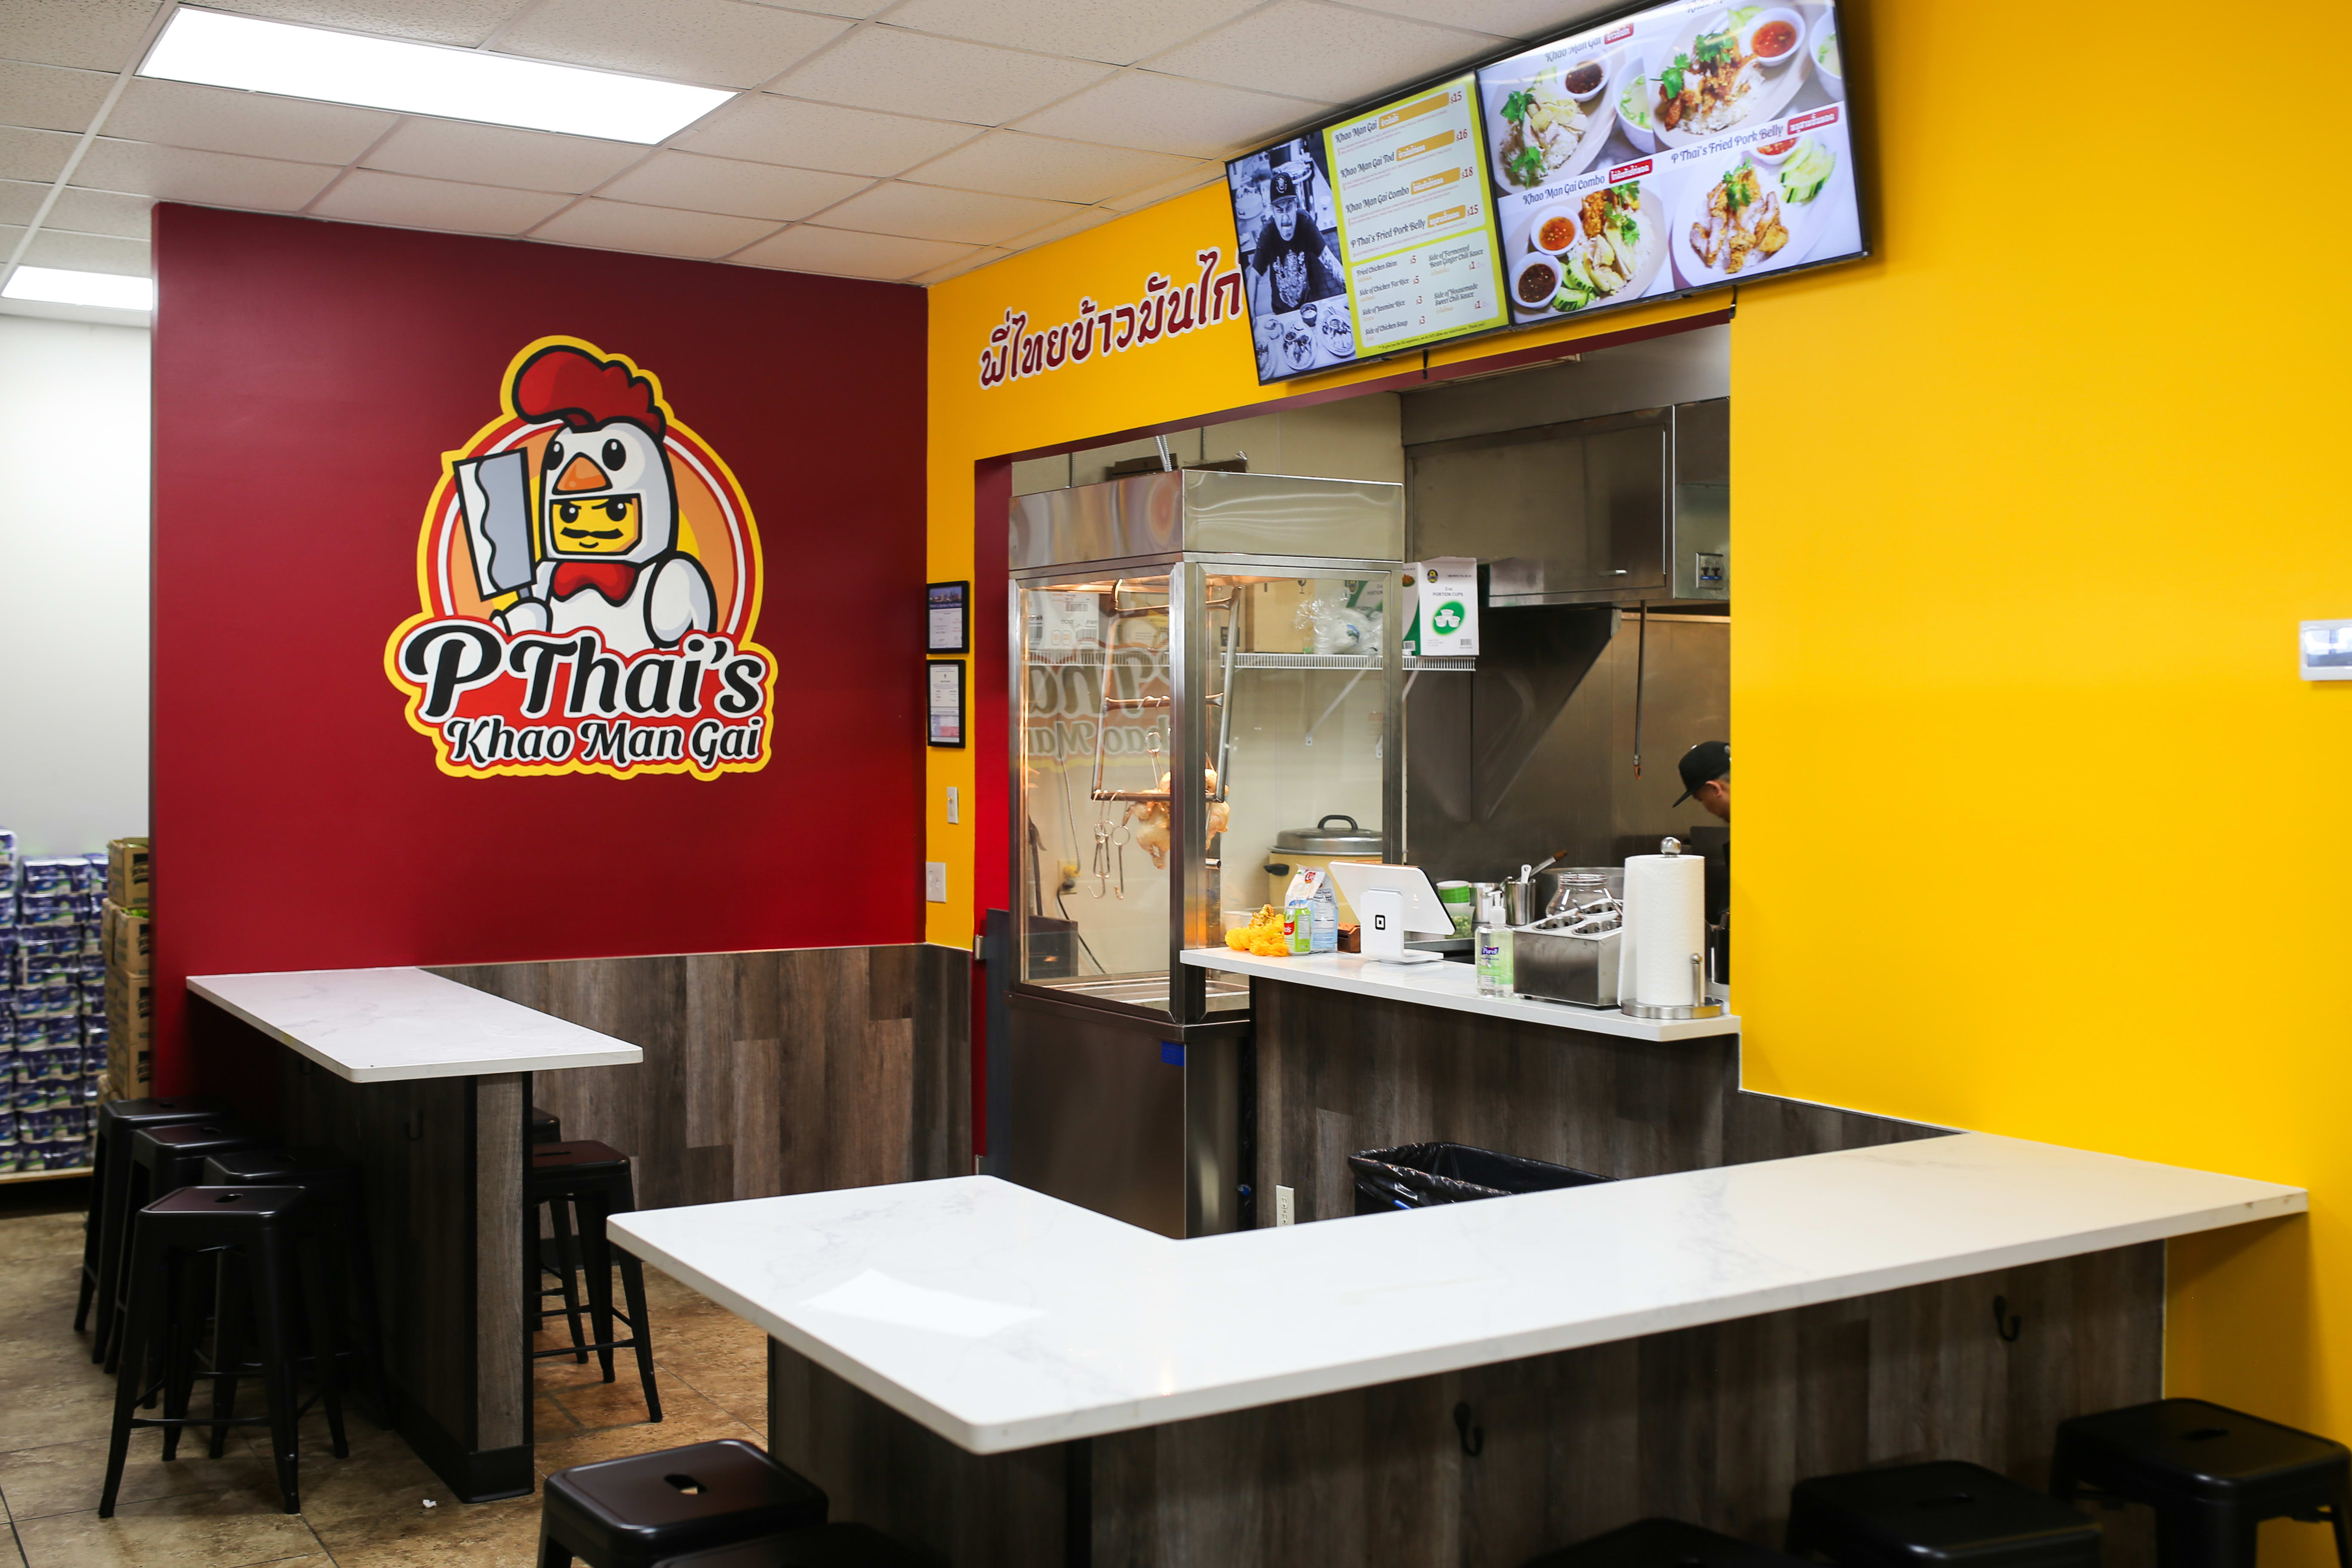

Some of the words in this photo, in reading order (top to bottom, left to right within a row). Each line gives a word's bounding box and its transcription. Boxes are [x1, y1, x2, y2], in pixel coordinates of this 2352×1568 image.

[1546, 49, 1567, 62] Khao
[1568, 41, 1587, 54] Man
[1451, 91, 1462, 104] $15
[1335, 132, 1351, 143] Khao
[1352, 126, 1366, 136] Man
[1367, 120, 1377, 133] Gai
[1456, 129, 1467, 141] $16
[1671, 153, 1678, 163] P
[1680, 145, 1707, 161] Thai's
[1709, 137, 1733, 154] Fried
[1734, 131, 1758, 146] Pork
[1759, 124, 1783, 139] Belly
[1340, 167, 1357, 178] Khao
[1358, 162, 1372, 172] Man
[1372, 156, 1382, 168] Gai
[1383, 152, 1395, 163] Tod
[1462, 167, 1473, 179] $18
[1523, 192, 1544, 205] Khao
[1545, 188, 1563, 199] Man
[1565, 181, 1577, 195] Gai
[1578, 175, 1605, 189] Combo
[1345, 203, 1362, 213] Khao
[1363, 198, 1377, 208] Man
[1378, 192, 1387, 205] Gai
[1388, 187, 1409, 199] Combo
[1467, 205, 1479, 216] $15
[1351, 239, 1356, 248] P
[1357, 234, 1375, 246] Thai's
[1375, 228, 1392, 241] Fried
[1393, 224, 1409, 236] Pork
[1409, 219, 1426, 231] Belly
[1442, 256, 1458, 266] Ginger
[1470, 249, 1483, 257] Sauce
[1443, 244, 1470, 258] Fermented
[1410, 255, 1416, 264] $5
[1357, 267, 1368, 276] Fried
[1369, 264, 1385, 273] Chicken
[1386, 260, 1398, 269] Skins
[1413, 276, 1419, 285] $5
[1374, 283, 1390, 292] Chicken
[1448, 283, 1478, 295] Housemade
[1416, 296, 1422, 305] $3
[1436, 298, 1449, 306] Sweet
[1377, 303, 1395, 313] Jasmine
[980, 251, 1241, 386] พี่ไทยข้าวมันไก
[1419, 315, 1425, 325] $3
[1379, 323, 1396, 331] Chicken
[404, 625, 502, 717] P
[509, 636, 763, 714] Thai's
[447, 719, 571, 764] Khao
[580, 723, 681, 768] Man
[692, 719, 763, 765] Gai
